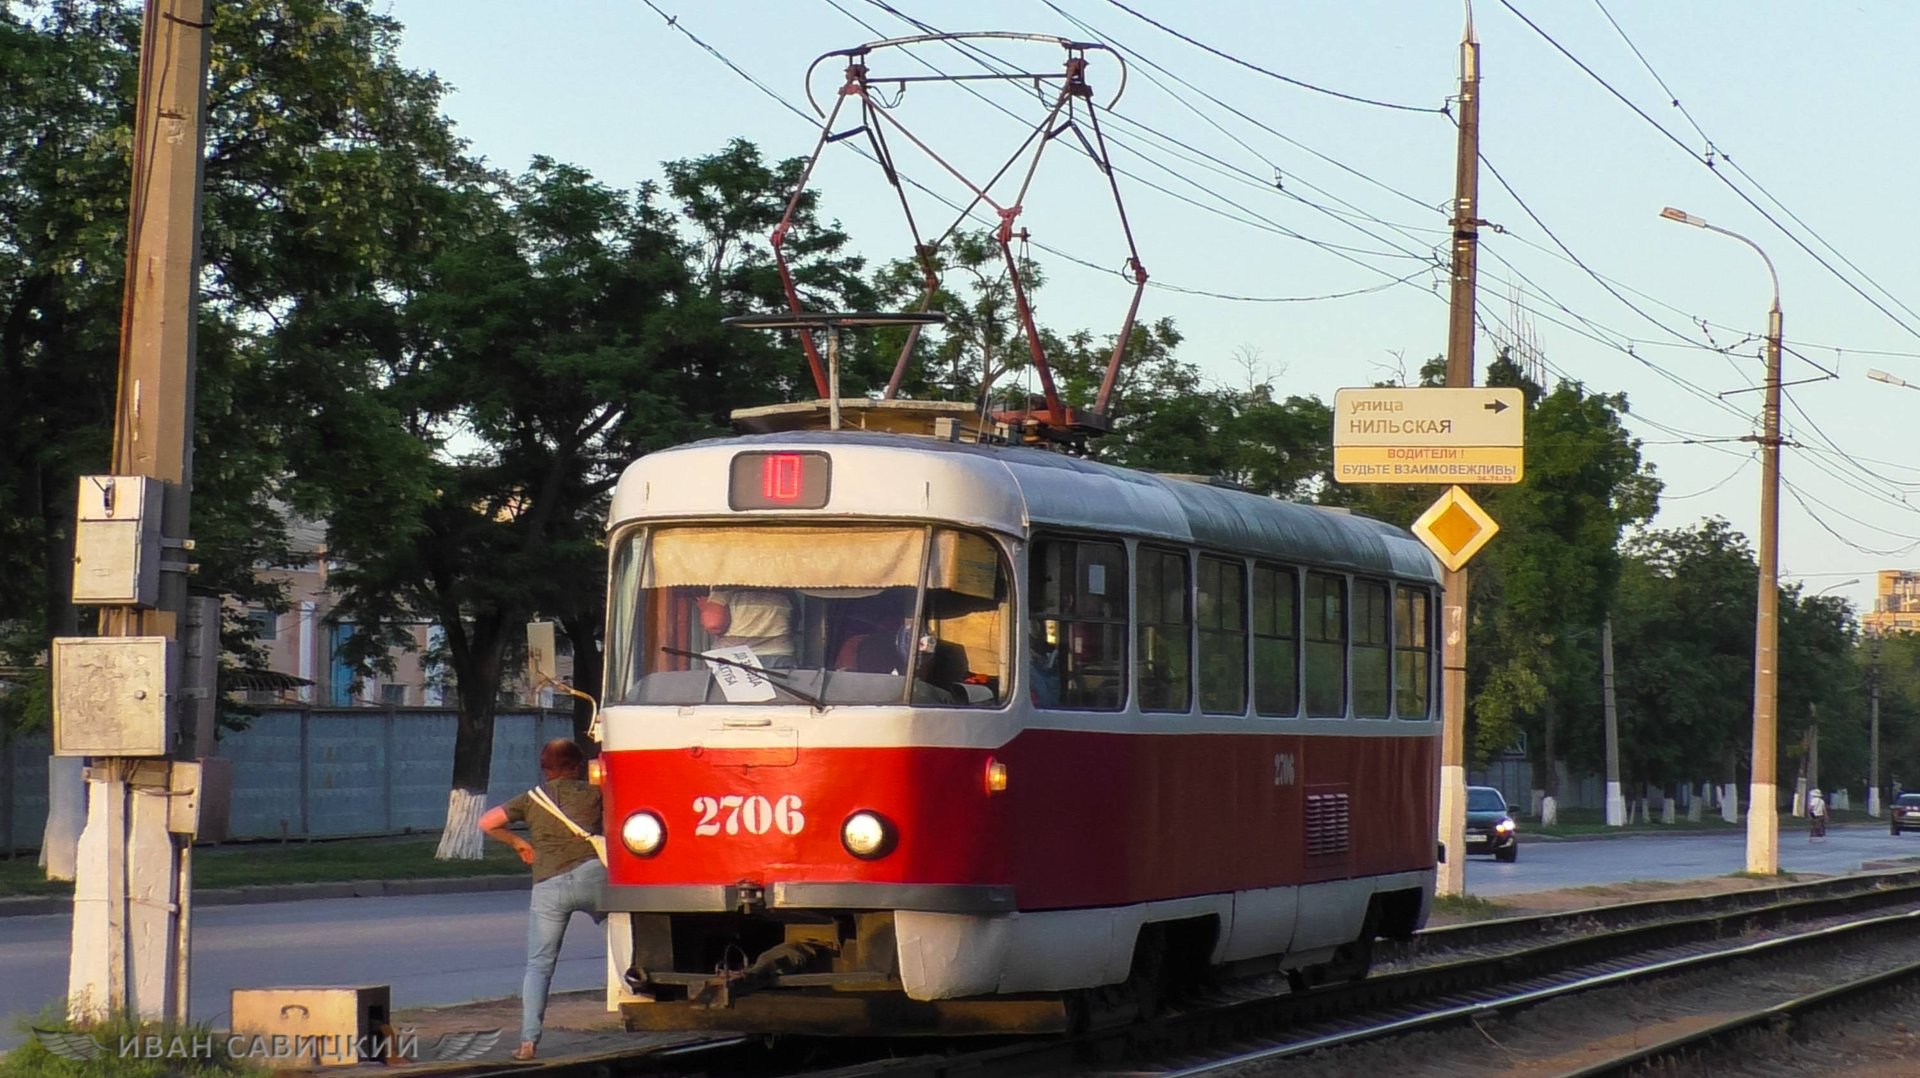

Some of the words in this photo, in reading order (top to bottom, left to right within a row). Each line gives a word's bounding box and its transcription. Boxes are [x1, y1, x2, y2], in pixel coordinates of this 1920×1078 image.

[1351, 400, 1403, 414] улица
[1350, 420, 1451, 433] НИЛЬСКАЯ
[1343, 465, 1389, 475] БУДЬТЕ
[1394, 465, 1516, 475] ВЗАИМОВЕЖЛИВЫ
[764, 455, 802, 500] 10
[692, 794, 805, 836] 2706
